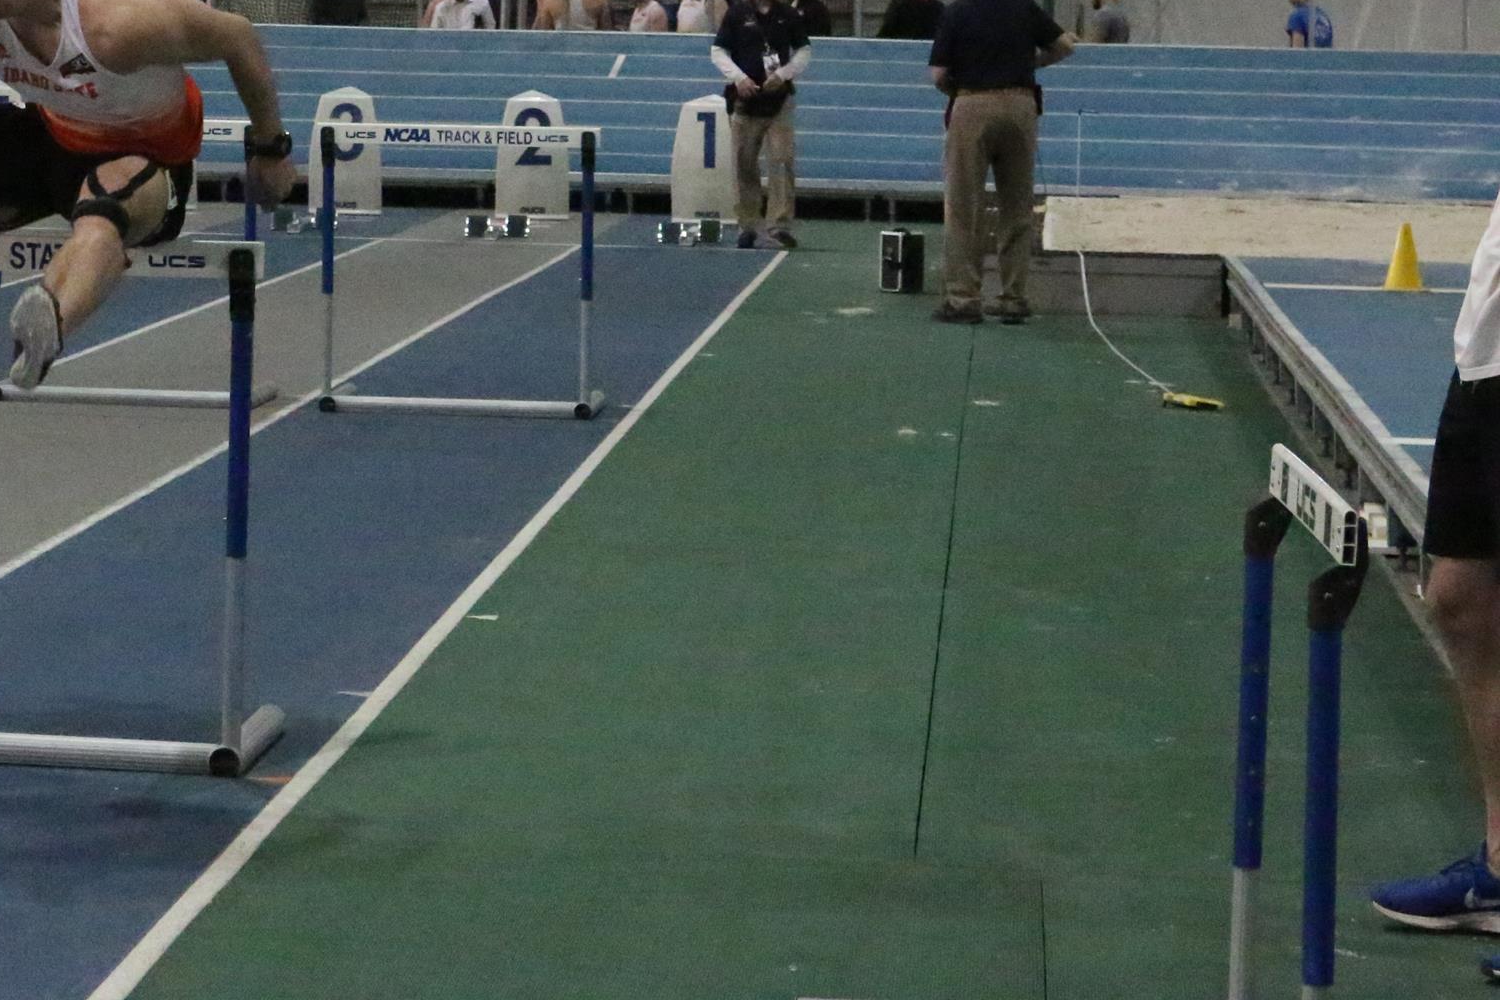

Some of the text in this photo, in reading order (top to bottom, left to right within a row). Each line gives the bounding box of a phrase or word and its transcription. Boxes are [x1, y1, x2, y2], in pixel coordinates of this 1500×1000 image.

[345, 128, 569, 145] UCS NCAA TRACK & FIELD UCS
[514, 107, 552, 166] 2
[697, 112, 716, 169] 1
[9, 241, 63, 271] STA
[148, 254, 206, 269] UCS
